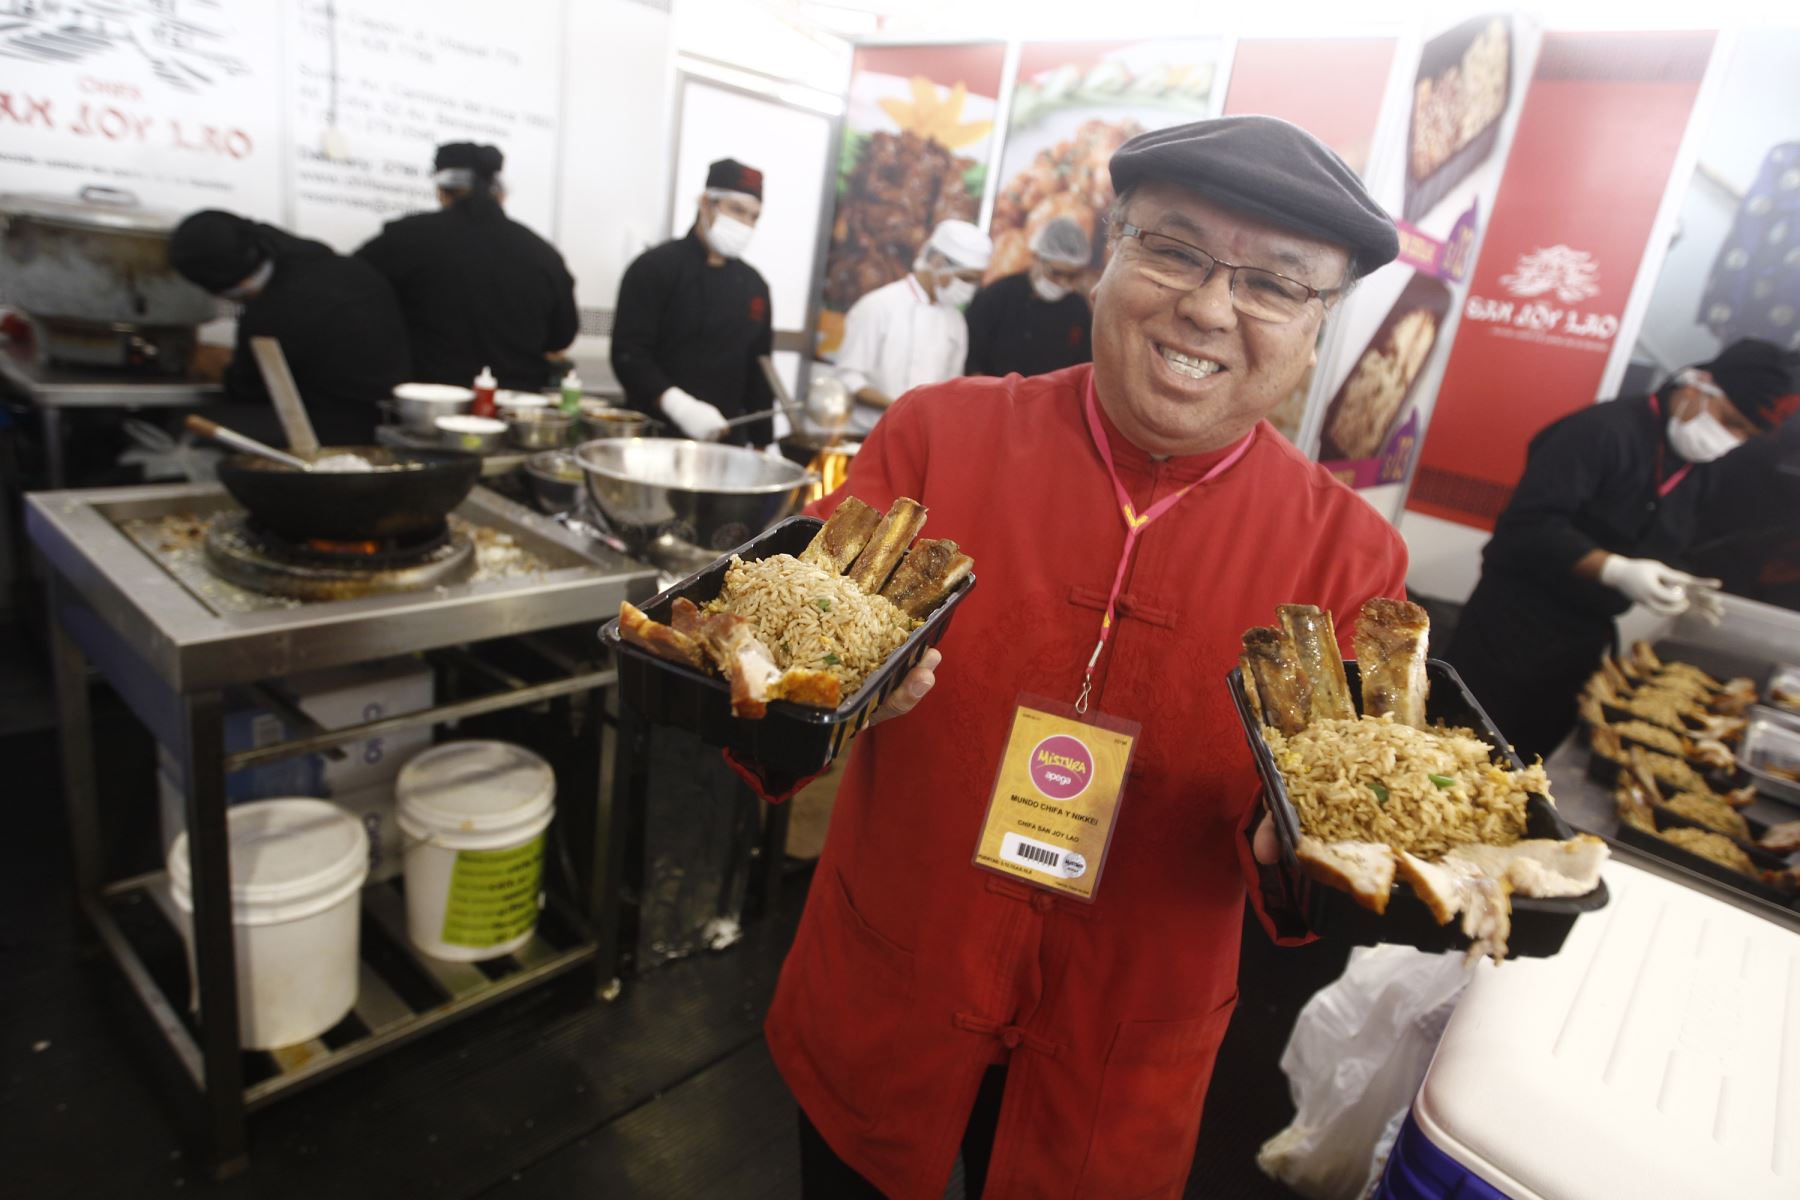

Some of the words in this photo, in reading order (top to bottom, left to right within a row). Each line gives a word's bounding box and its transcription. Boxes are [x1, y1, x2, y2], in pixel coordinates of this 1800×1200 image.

[71, 102, 153, 140] JOY
[1564, 310, 1618, 340] LAO
[1011, 794, 1039, 808] MUNDO
[1040, 803, 1063, 815] CHIFA
[1065, 810, 1071, 818] Y
[1071, 812, 1099, 826] NIKKEI
[1017, 819, 1036, 830] CHIFA
[1037, 825, 1051, 834] SAN
[1052, 830, 1065, 839] JOY
[1065, 833, 1080, 843] LAO
